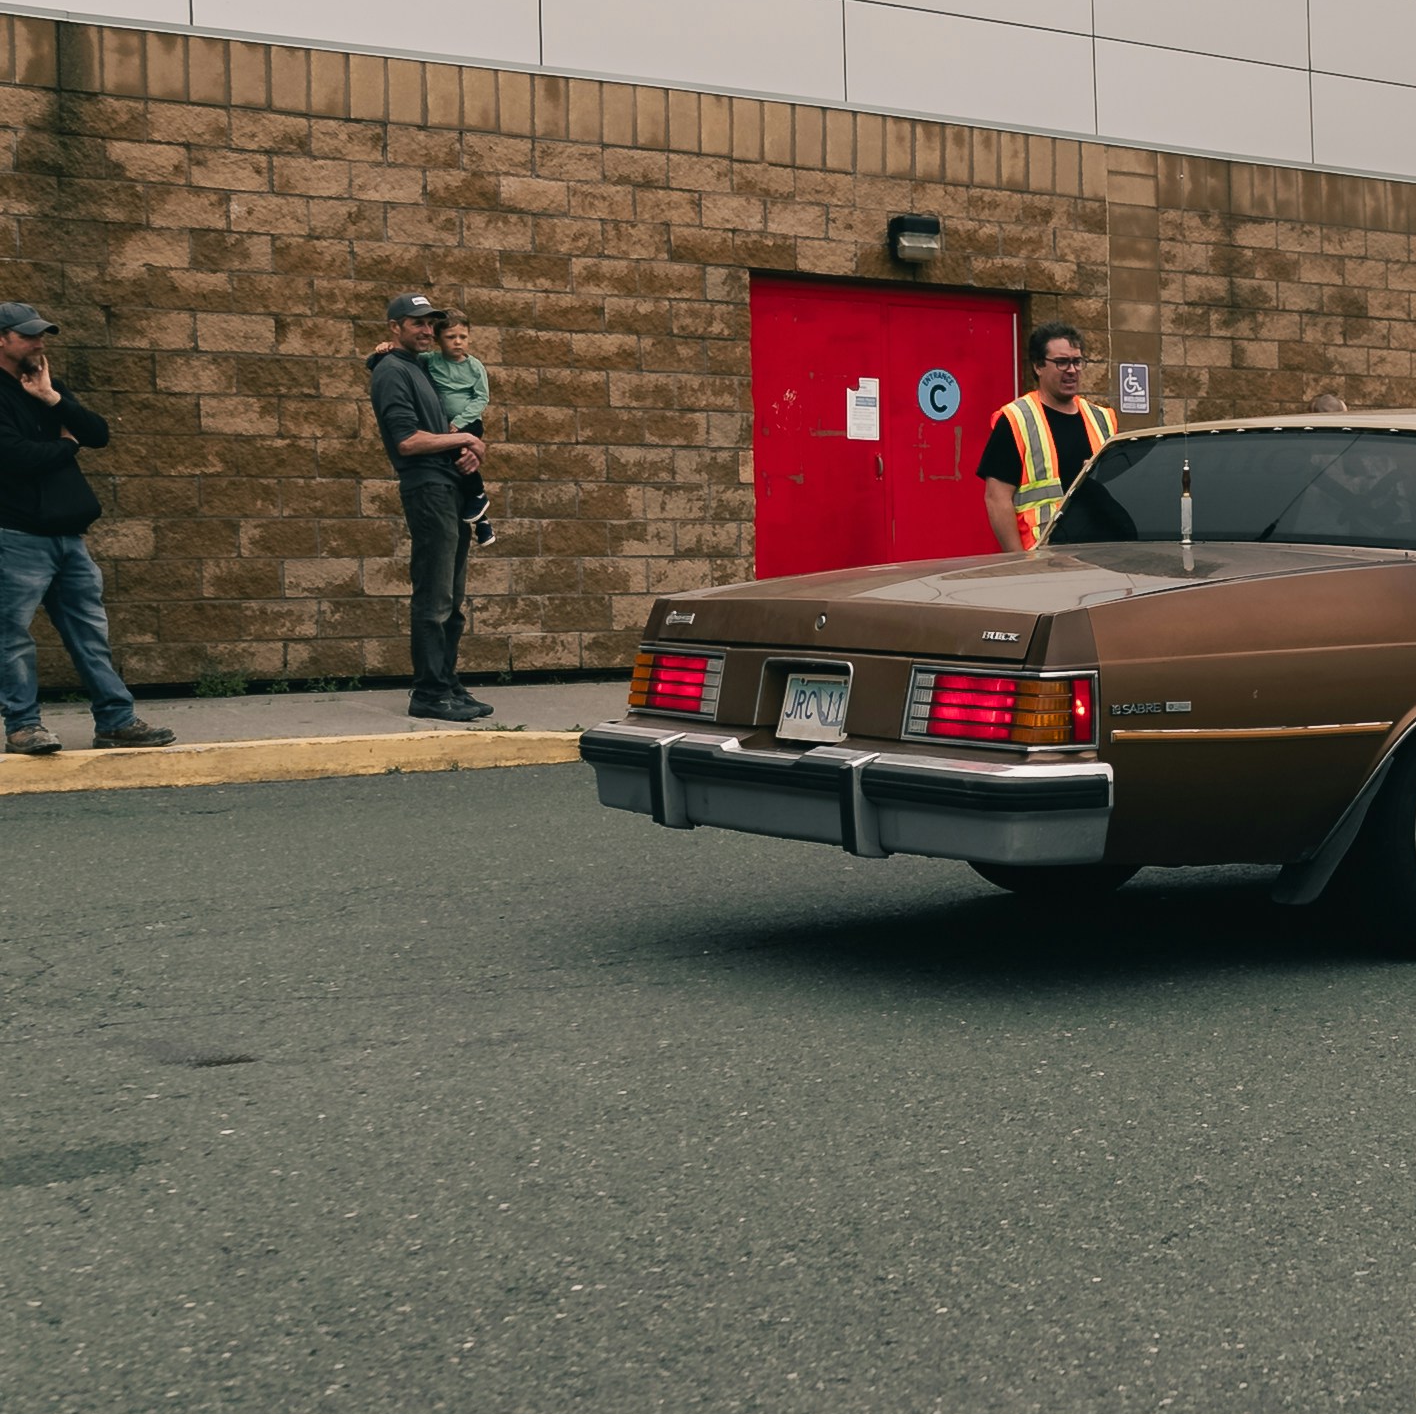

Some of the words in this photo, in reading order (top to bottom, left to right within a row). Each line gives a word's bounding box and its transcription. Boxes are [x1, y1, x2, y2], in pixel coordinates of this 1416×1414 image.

[922, 371, 954, 386] ENTRANCE
[930, 384, 948, 413] C
[982, 631, 1020, 642] BUICK
[785, 689, 817, 720] JRC
